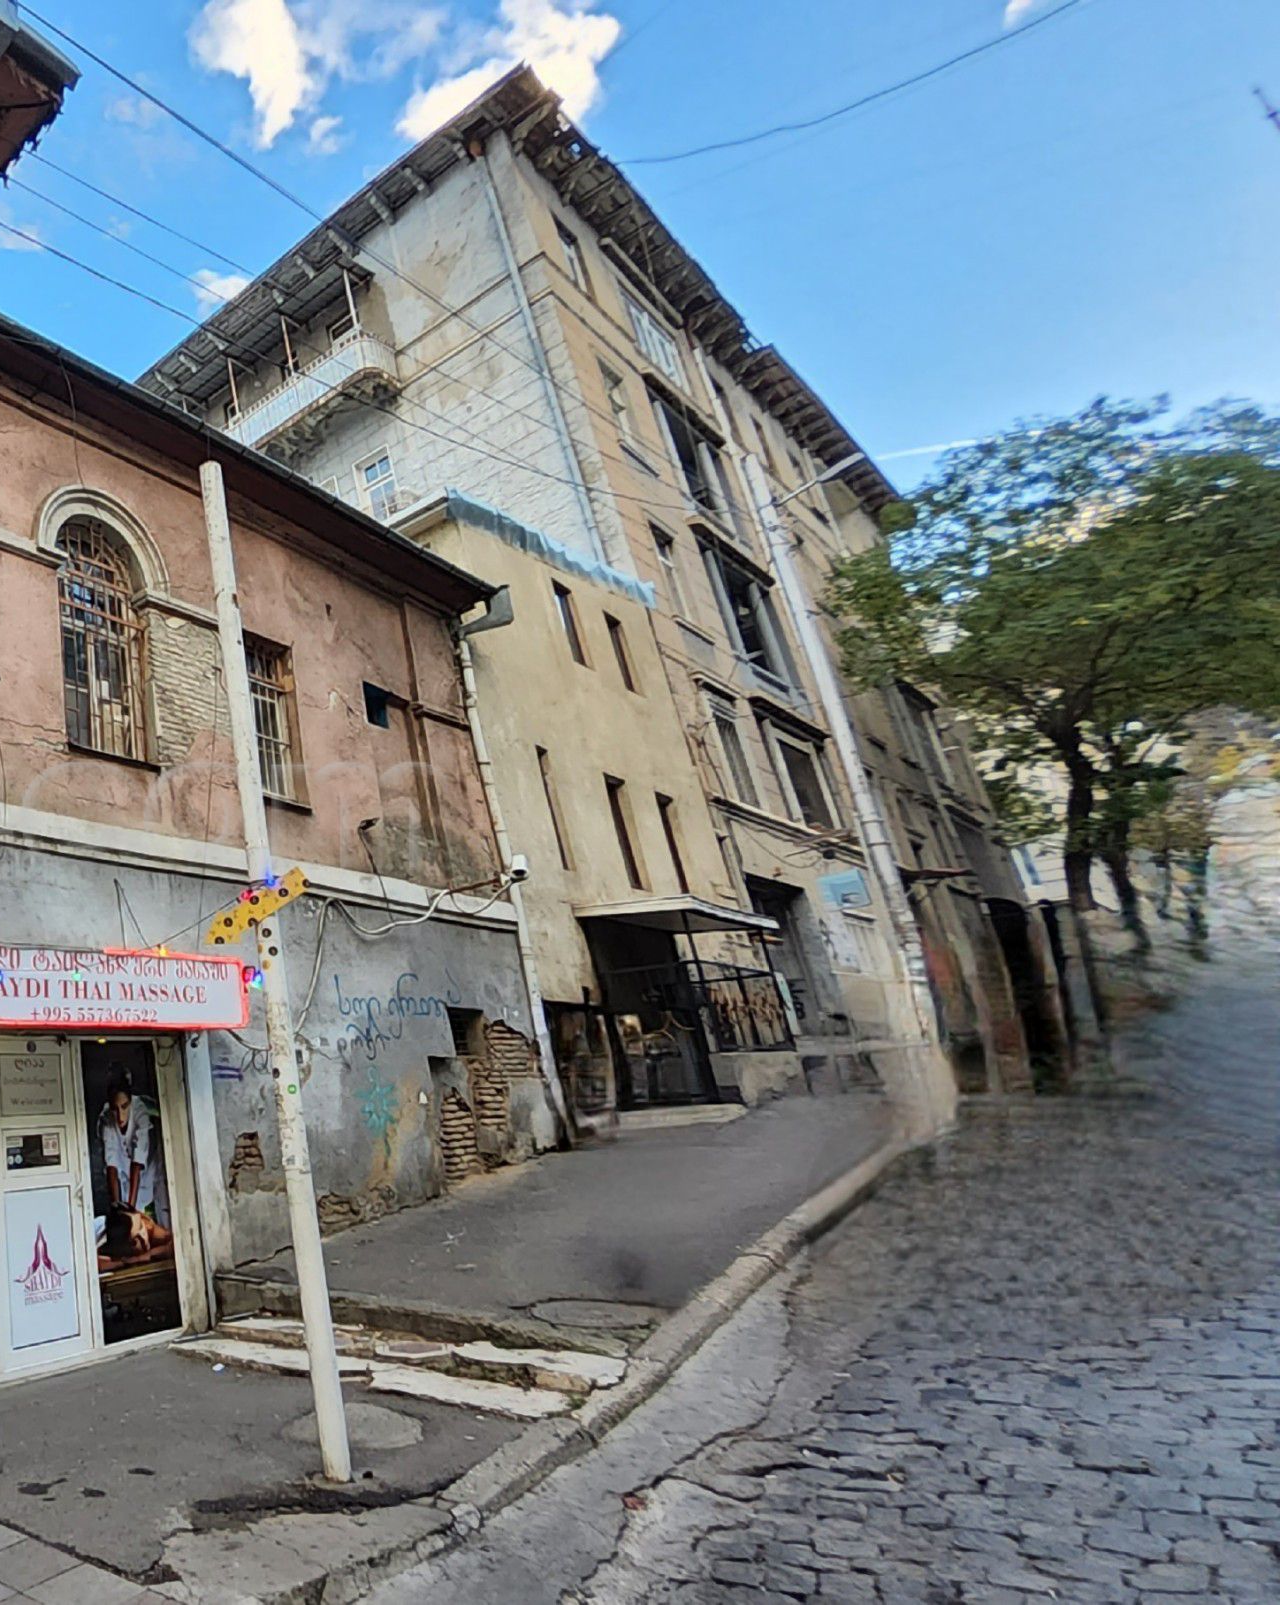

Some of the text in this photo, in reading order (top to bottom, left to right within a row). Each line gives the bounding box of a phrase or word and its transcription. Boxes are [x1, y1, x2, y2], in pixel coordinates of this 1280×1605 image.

[58, 978, 112, 1000] THAI
[119, 982, 208, 1004] MASSAGE
[31, 1006, 158, 1023] +995 557367522
